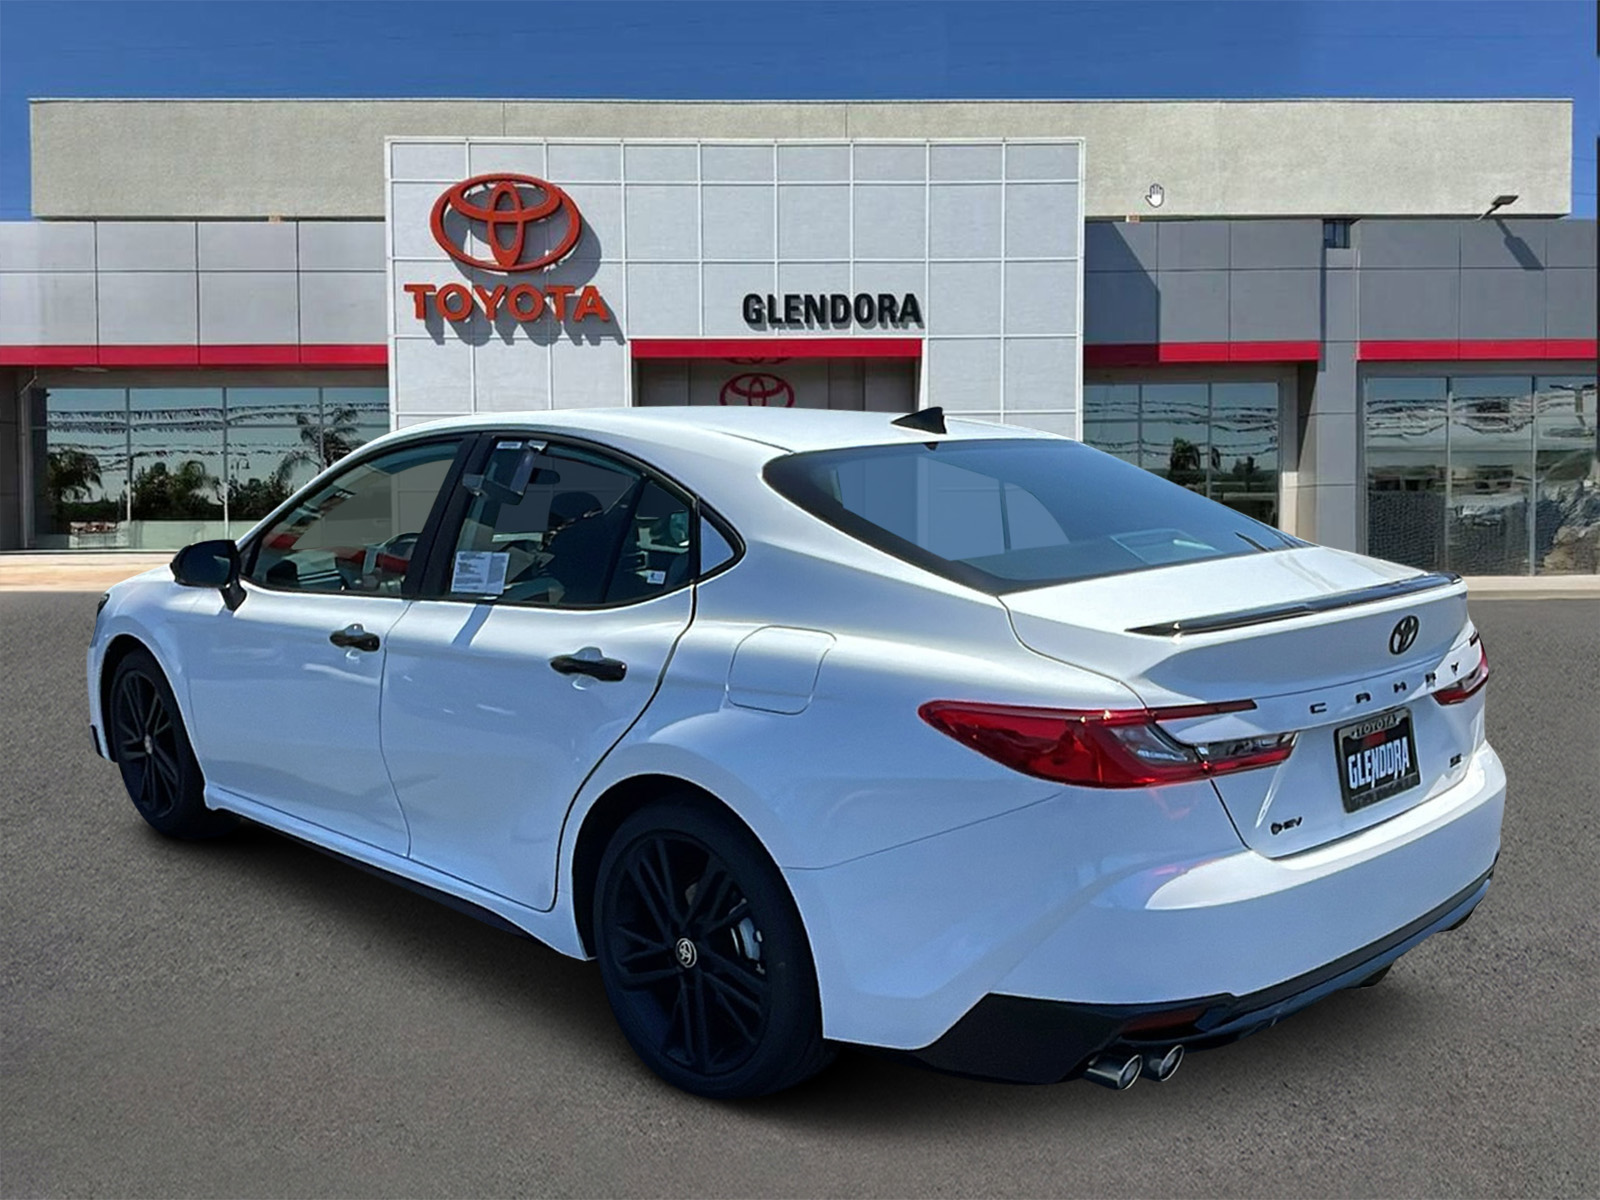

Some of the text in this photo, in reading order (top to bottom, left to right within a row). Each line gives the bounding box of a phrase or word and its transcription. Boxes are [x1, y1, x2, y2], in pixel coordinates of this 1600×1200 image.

[404, 284, 609, 322] TOYOTA
[742, 293, 922, 325] GLENDORA
[1310, 662, 1459, 714] CAMRY
[1357, 714, 1397, 736] TOYOTA
[1347, 736, 1410, 789] GLENDORA
